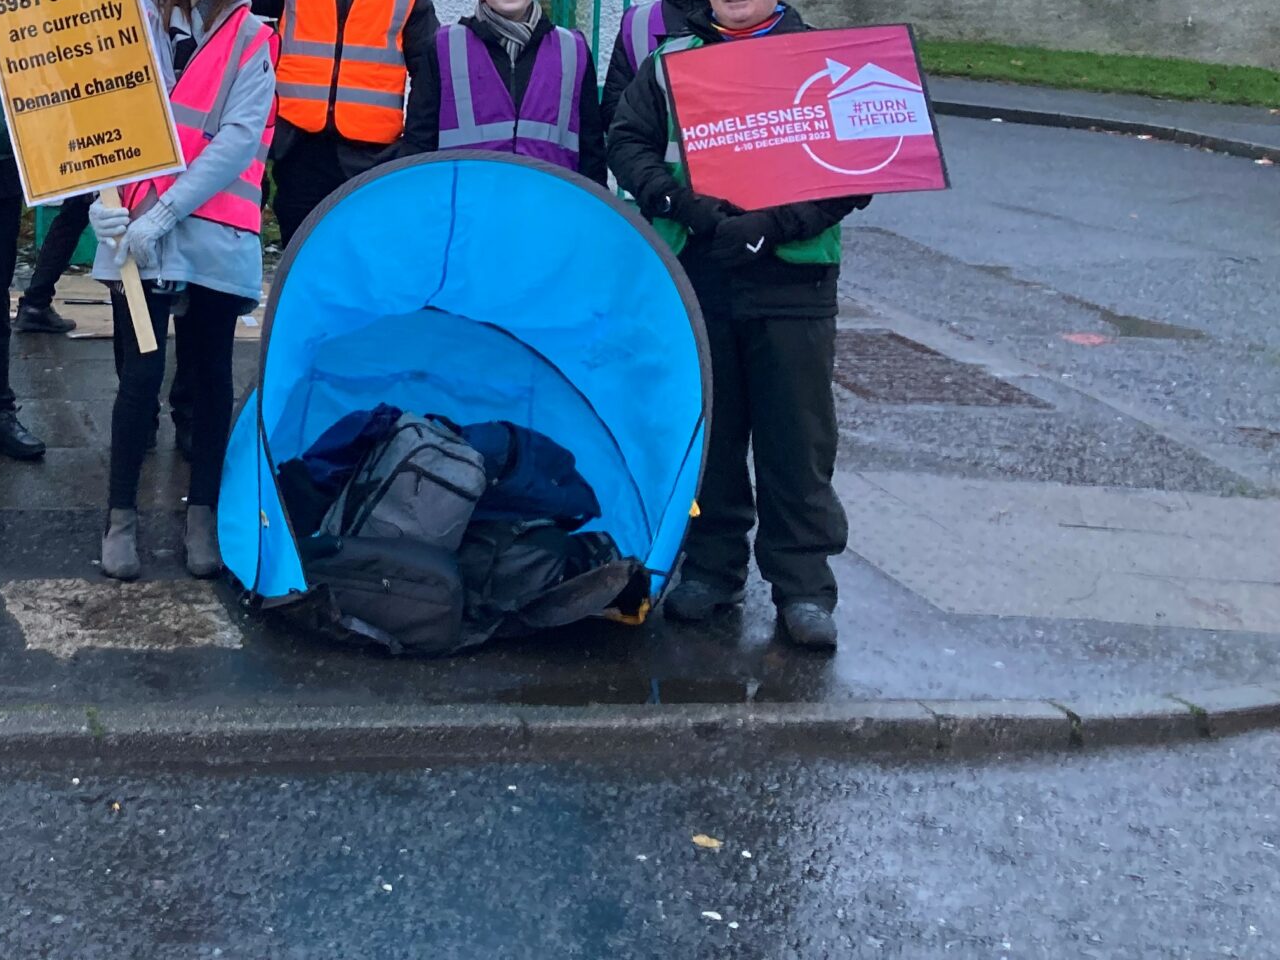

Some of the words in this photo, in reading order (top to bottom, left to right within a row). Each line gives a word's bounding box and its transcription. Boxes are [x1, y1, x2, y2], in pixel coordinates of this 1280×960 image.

[8, 22, 38, 43] are
[42, 1, 123, 34] currently
[5, 42, 94, 74] homeless
[98, 34, 115, 52] in
[119, 26, 139, 47] NI
[12, 82, 81, 113] Demand
[84, 65, 151, 96] change!
[848, 110, 917, 128] THETIDE
[852, 98, 907, 114] #TURN
[682, 104, 826, 141] HOMELESSNESS
[687, 128, 768, 152] AWARENESS
[771, 122, 811, 137] WEEK
[815, 120, 829, 131] NI
[68, 128, 122, 152] #HAW23
[734, 143, 753, 152] 4-10
[755, 133, 807, 149] DECEMBER
[809, 130, 831, 141] 2023
[59, 146, 141, 176] #TurnTheTide
